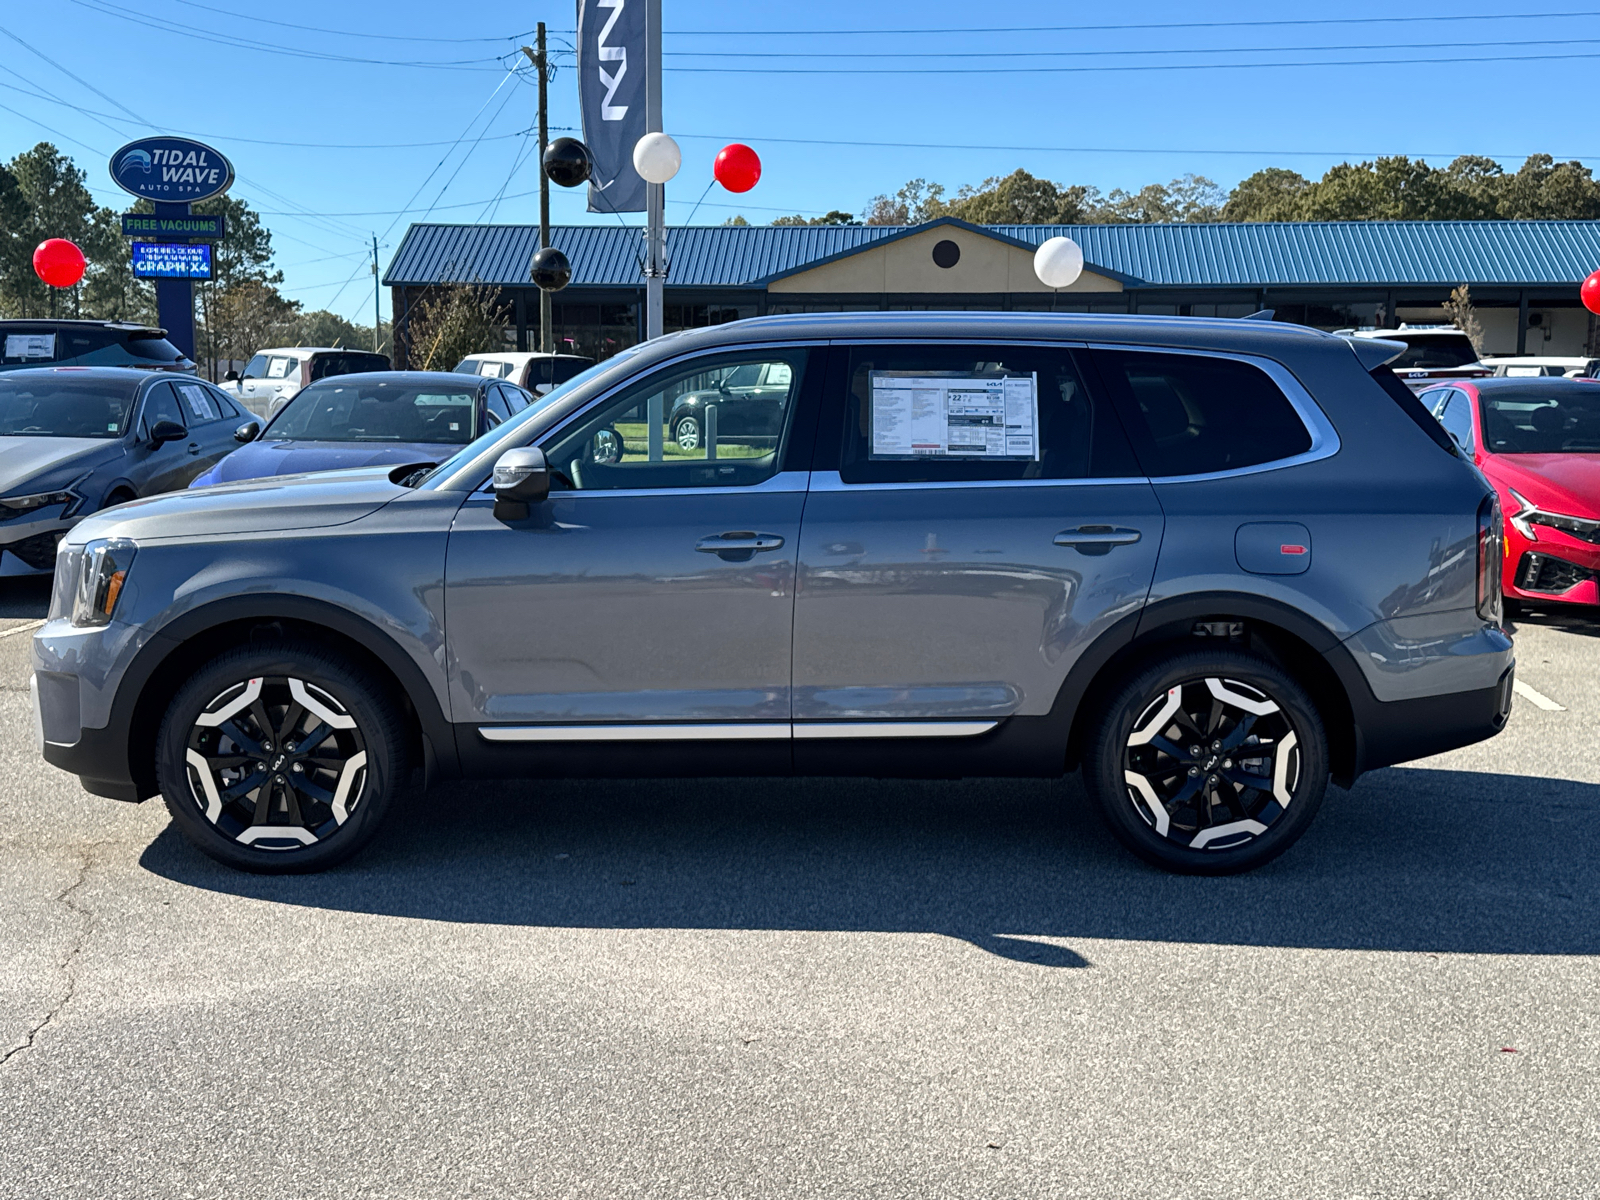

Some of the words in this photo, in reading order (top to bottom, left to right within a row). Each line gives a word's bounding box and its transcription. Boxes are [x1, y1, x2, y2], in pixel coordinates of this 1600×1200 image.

[152, 149, 208, 167] TIDAL
[162, 166, 220, 185] WAVE
[139, 183, 170, 192] AUTO
[178, 185, 201, 193] SPA
[126, 219, 157, 230] FREE
[160, 219, 217, 232] VACUUMS
[952, 394, 962, 402] 22
